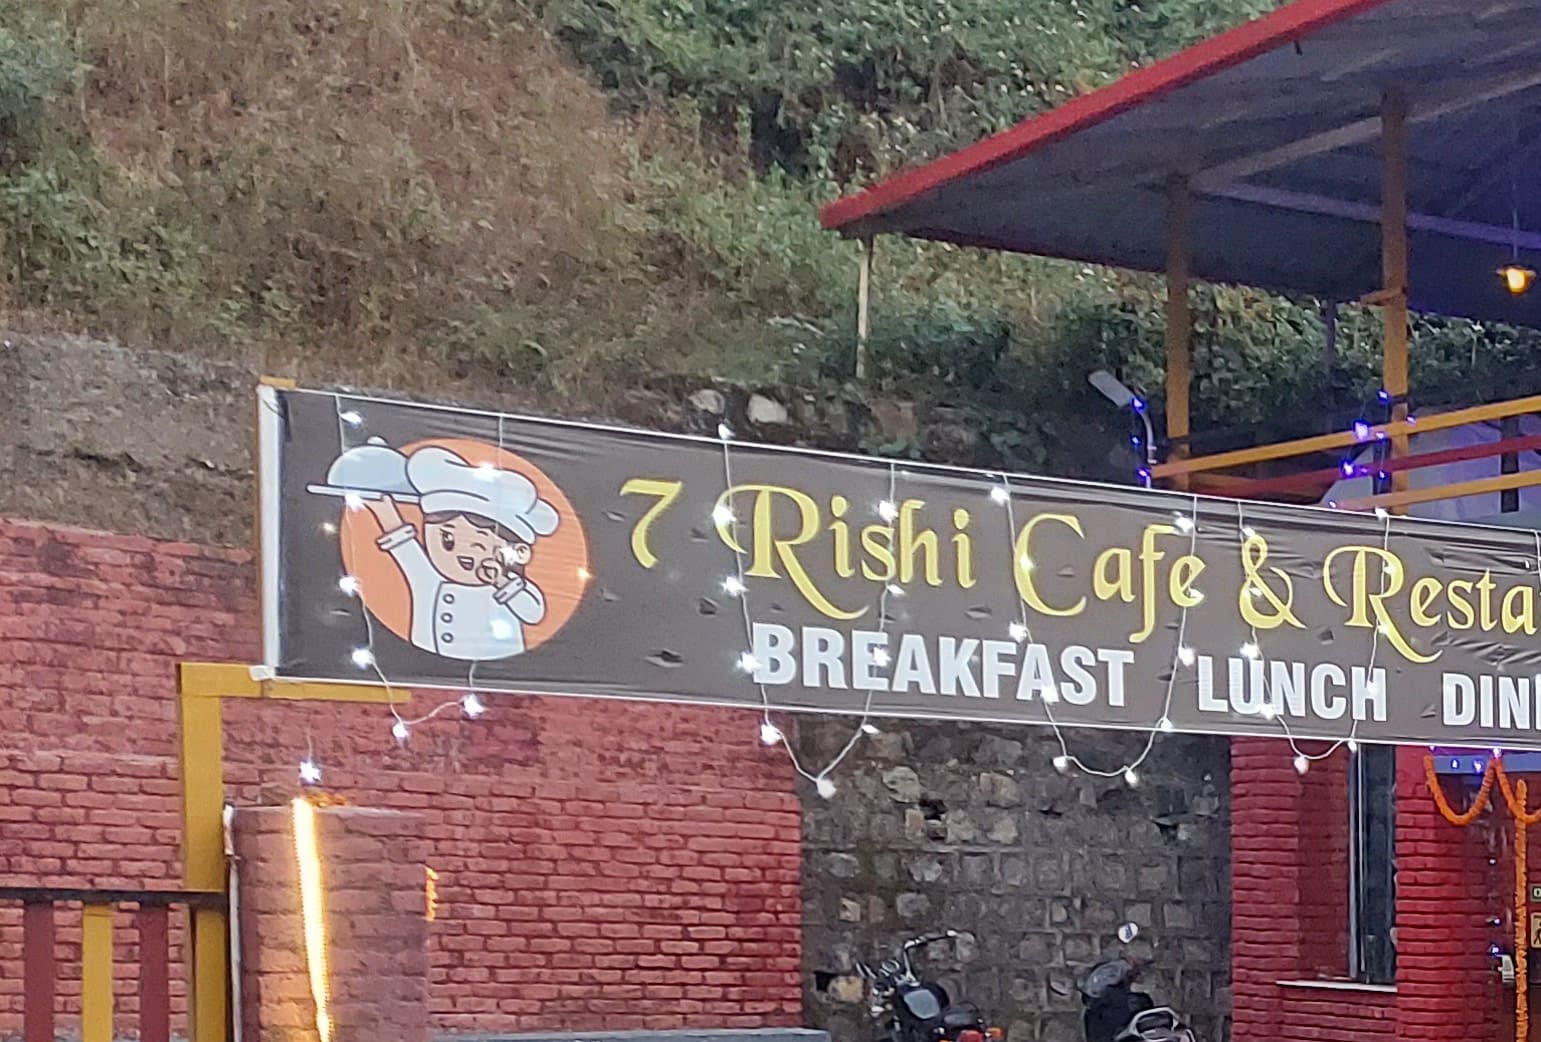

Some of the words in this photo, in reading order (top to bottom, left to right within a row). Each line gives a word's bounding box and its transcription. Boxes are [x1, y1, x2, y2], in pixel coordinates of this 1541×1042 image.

[621, 479, 682, 569] 7
[714, 485, 977, 620] Rishi
[1013, 513, 1206, 643] Cafe
[1240, 534, 1307, 632] &
[752, 623, 1135, 708] BREAKFAST
[1197, 655, 1388, 723] LUNCH
